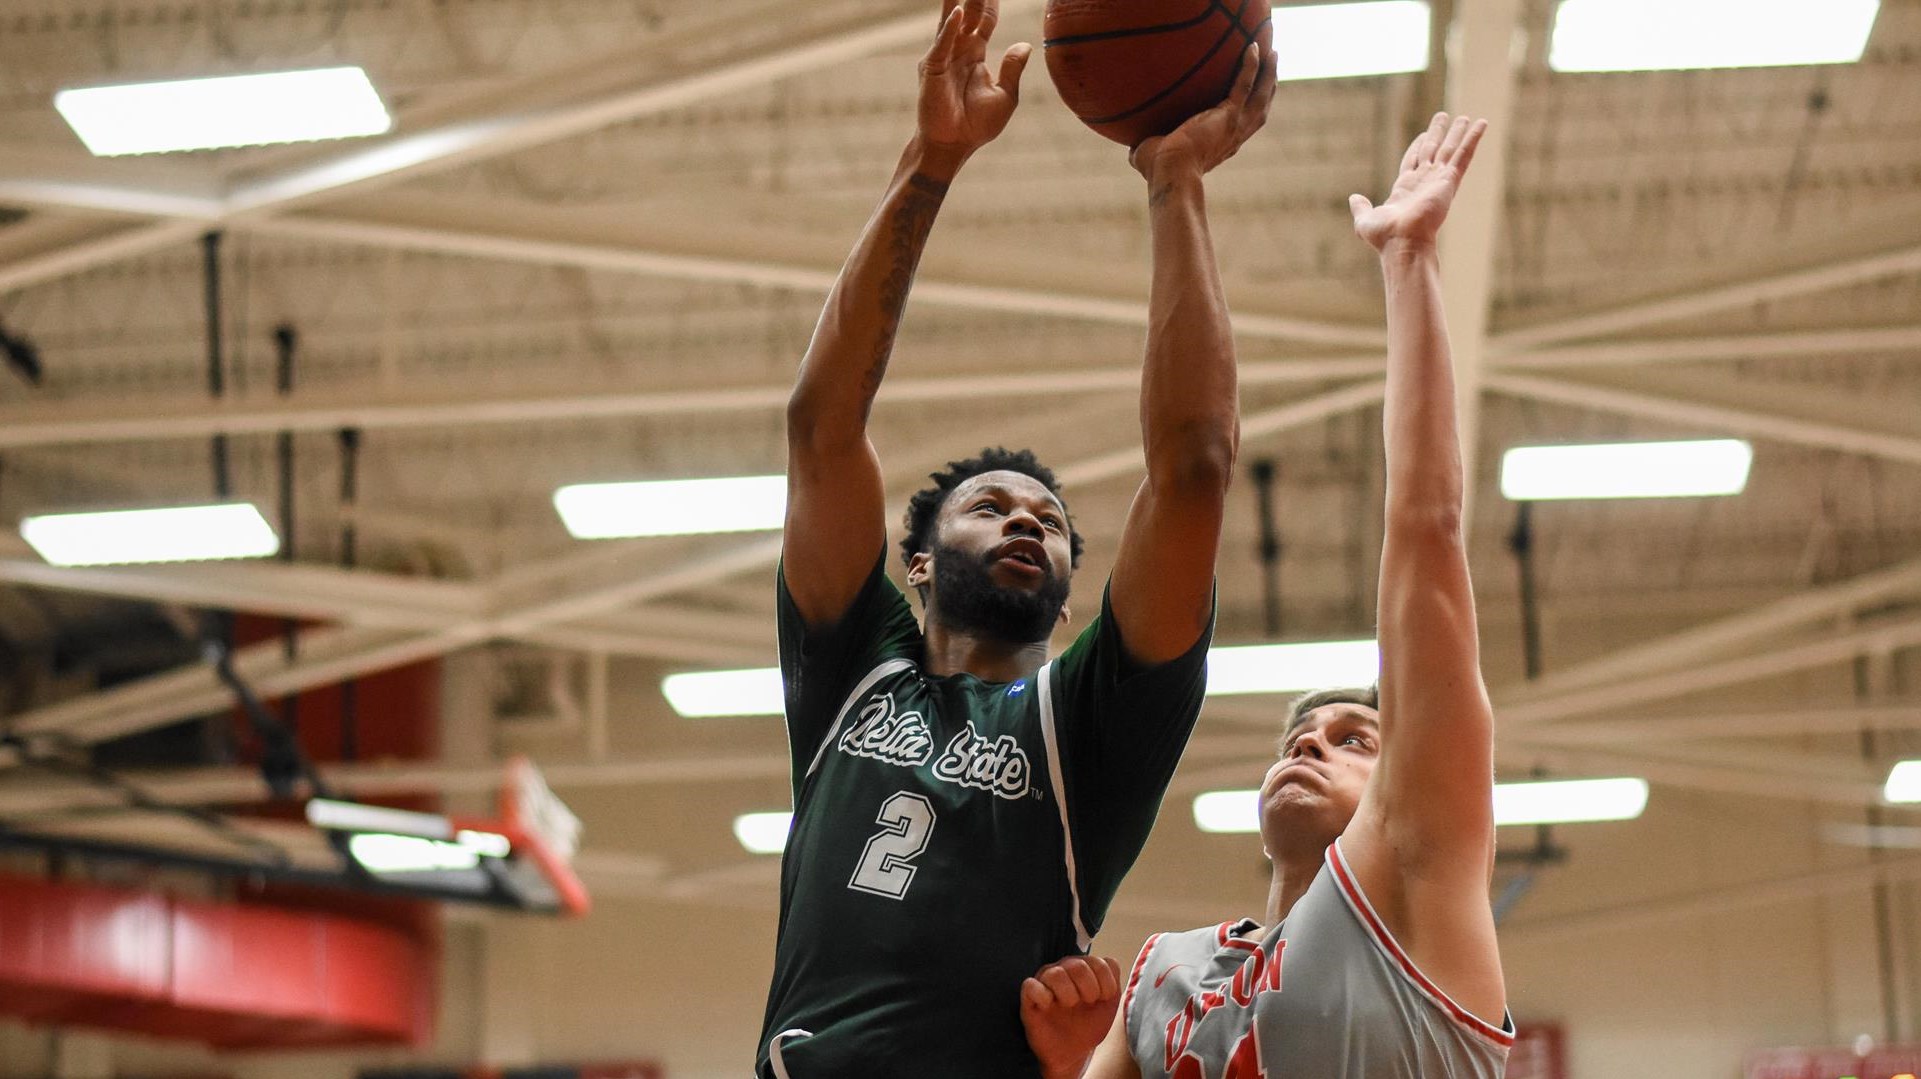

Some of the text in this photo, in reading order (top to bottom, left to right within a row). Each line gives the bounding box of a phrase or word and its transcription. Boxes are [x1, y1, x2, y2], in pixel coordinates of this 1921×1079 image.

[838, 693, 1030, 799] Delta State
[847, 790, 937, 900] 2
